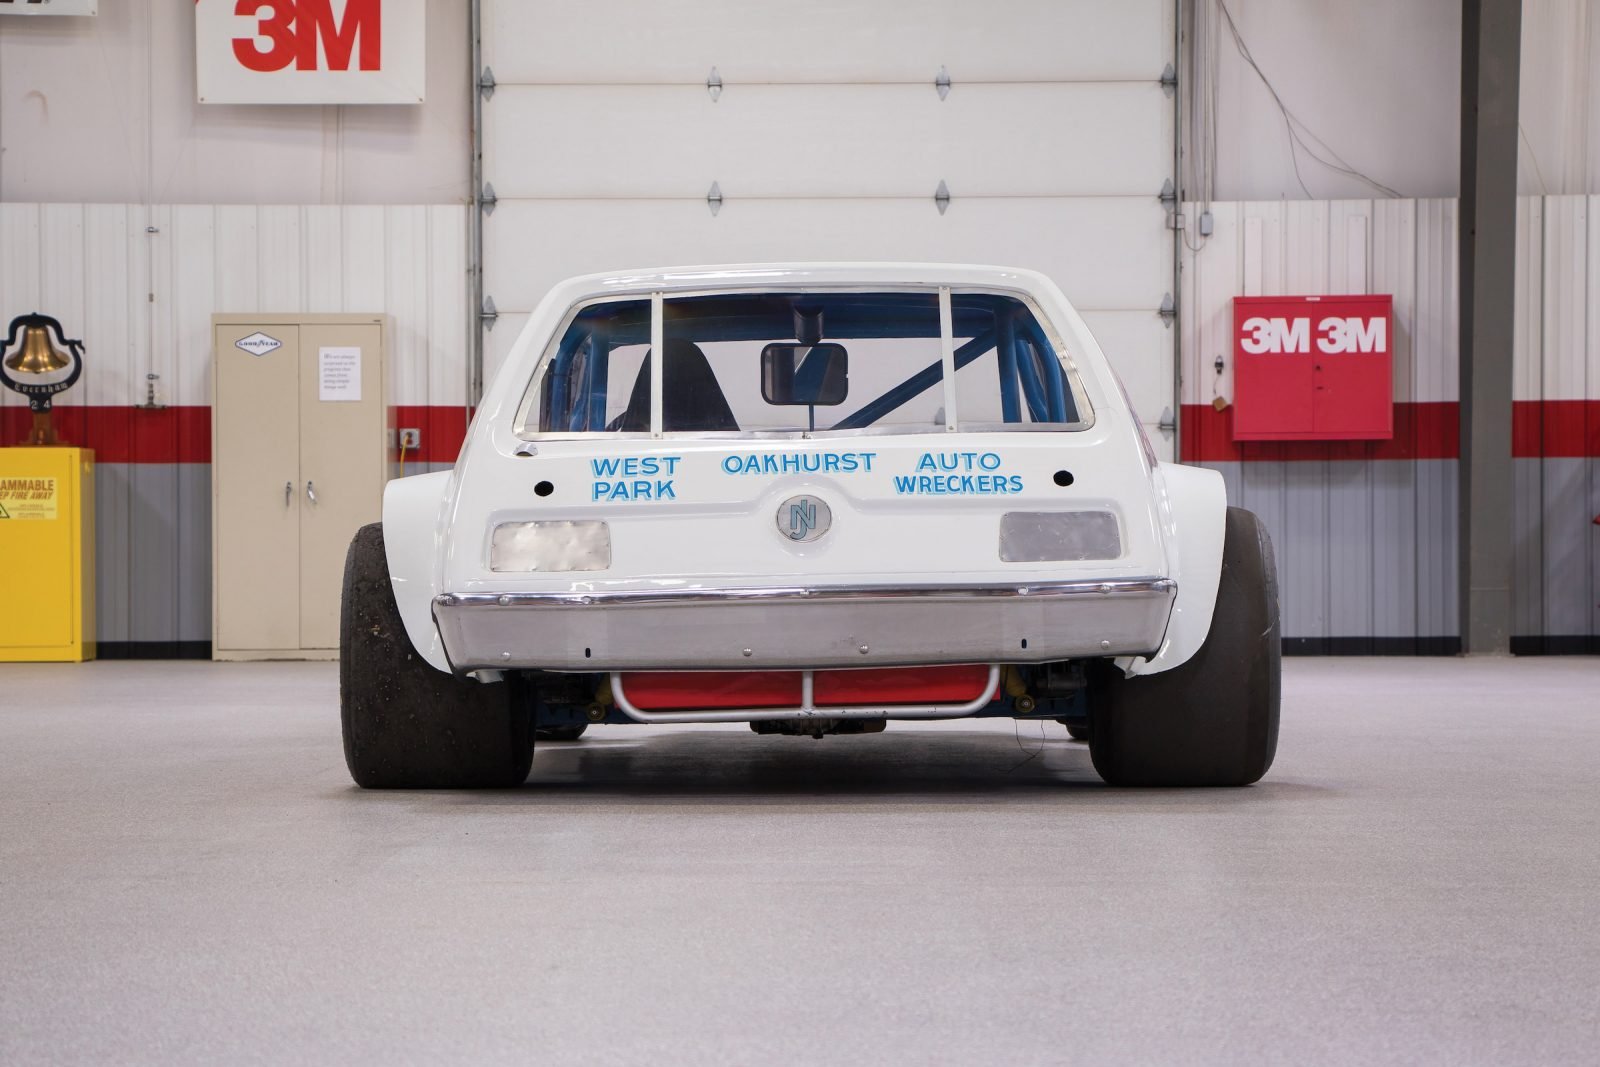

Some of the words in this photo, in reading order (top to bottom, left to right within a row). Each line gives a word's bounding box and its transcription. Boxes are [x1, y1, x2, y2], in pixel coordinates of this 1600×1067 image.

[231, 0, 381, 72] 3M
[1240, 317, 1310, 354] 3M
[1316, 317, 1387, 353] 3M
[592, 456, 681, 478] WEST
[722, 453, 877, 474] OAKHURST
[915, 452, 1001, 473] AUTO
[592, 480, 676, 501] PARK
[895, 474, 1024, 495] WRECKERS
[10, 491, 28, 500] FIRE
[29, 491, 53, 500] AWAY
